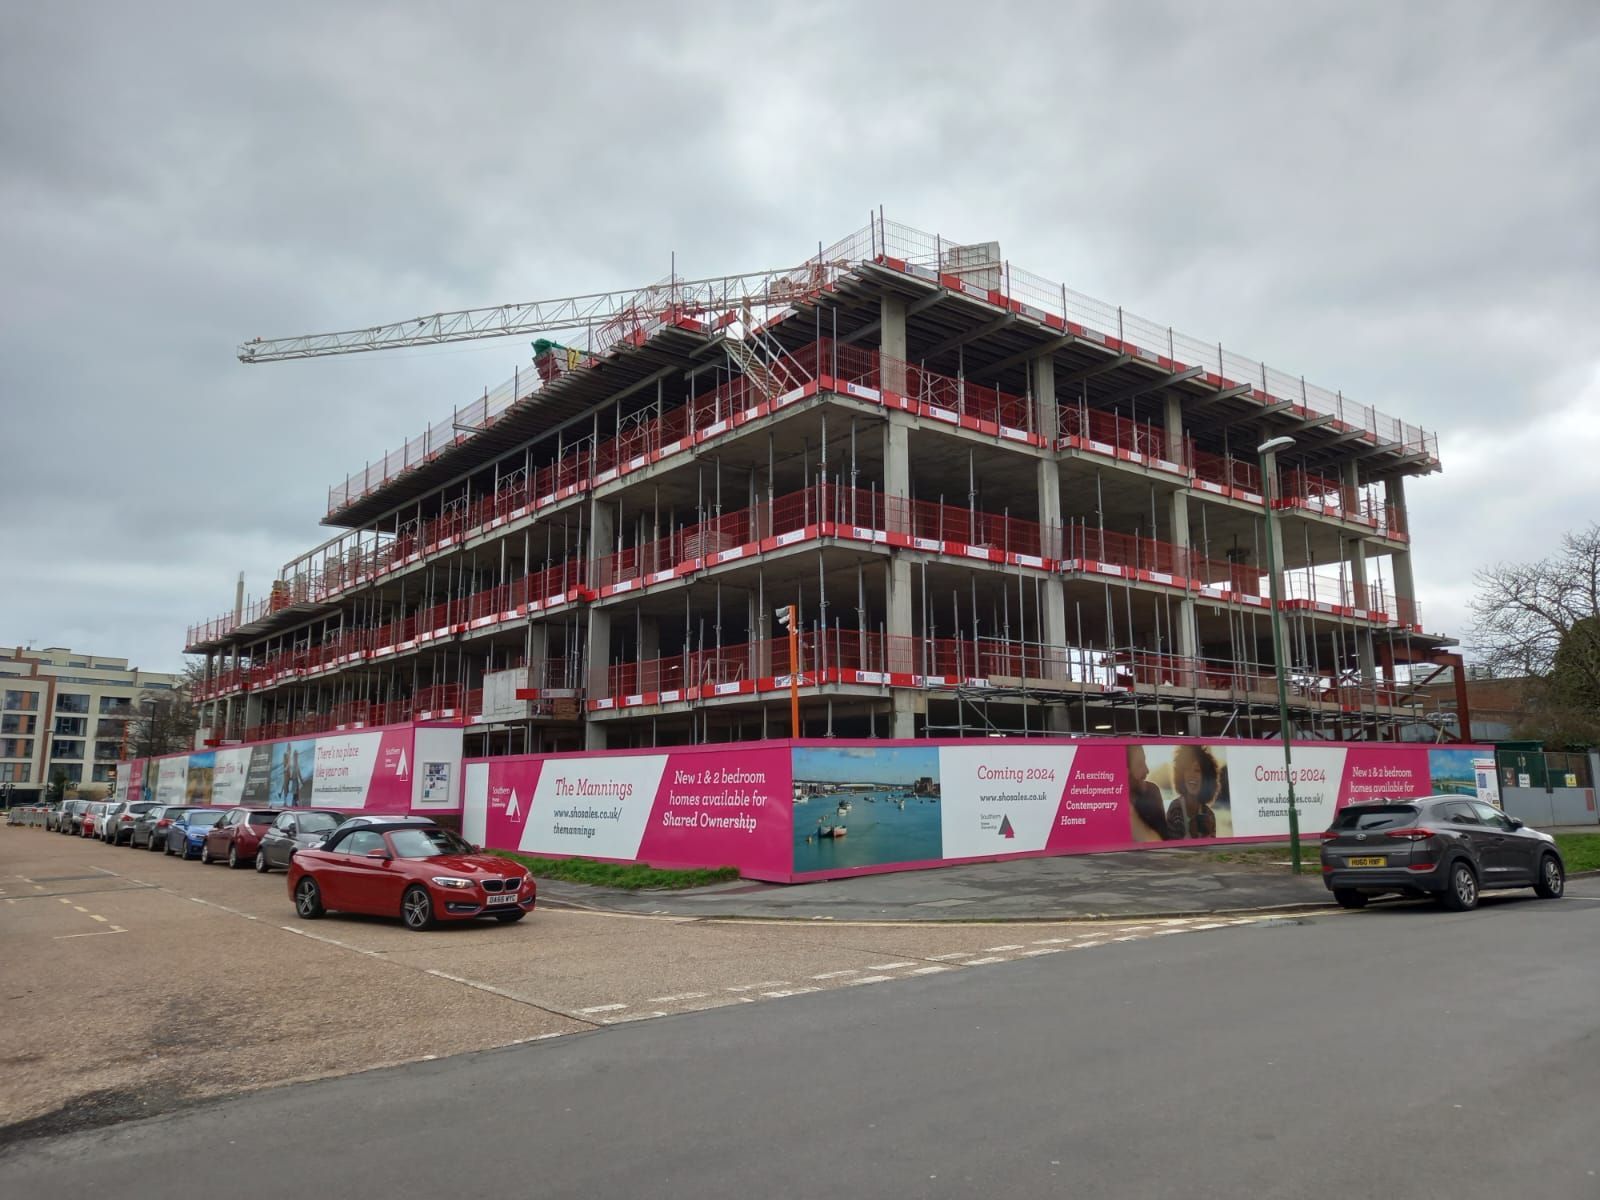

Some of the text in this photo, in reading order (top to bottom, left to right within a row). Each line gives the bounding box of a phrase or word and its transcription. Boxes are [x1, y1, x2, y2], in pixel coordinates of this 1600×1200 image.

[674, 767, 766, 784] New 1 & 2 bedroom
[977, 765, 1056, 784] Coming 2024
[1075, 770, 1115, 782] An exciting
[1300, 769, 1326, 784] 2024
[1352, 765, 1413, 778] New 1 & 2 bedroom
[556, 777, 633, 801] The Mannings
[1070, 784, 1123, 797] development of
[1350, 781, 1415, 793] homes available for
[669, 789, 768, 807] homes available for
[979, 791, 1048, 802] www.shosales.co.uk
[1066, 800, 1118, 812] Contemporary
[553, 806, 623, 822] www.shosales.co.uk/
[662, 810, 757, 833] Shared Ownership
[1061, 815, 1086, 825] Homes
[553, 822, 596, 838] themannings
